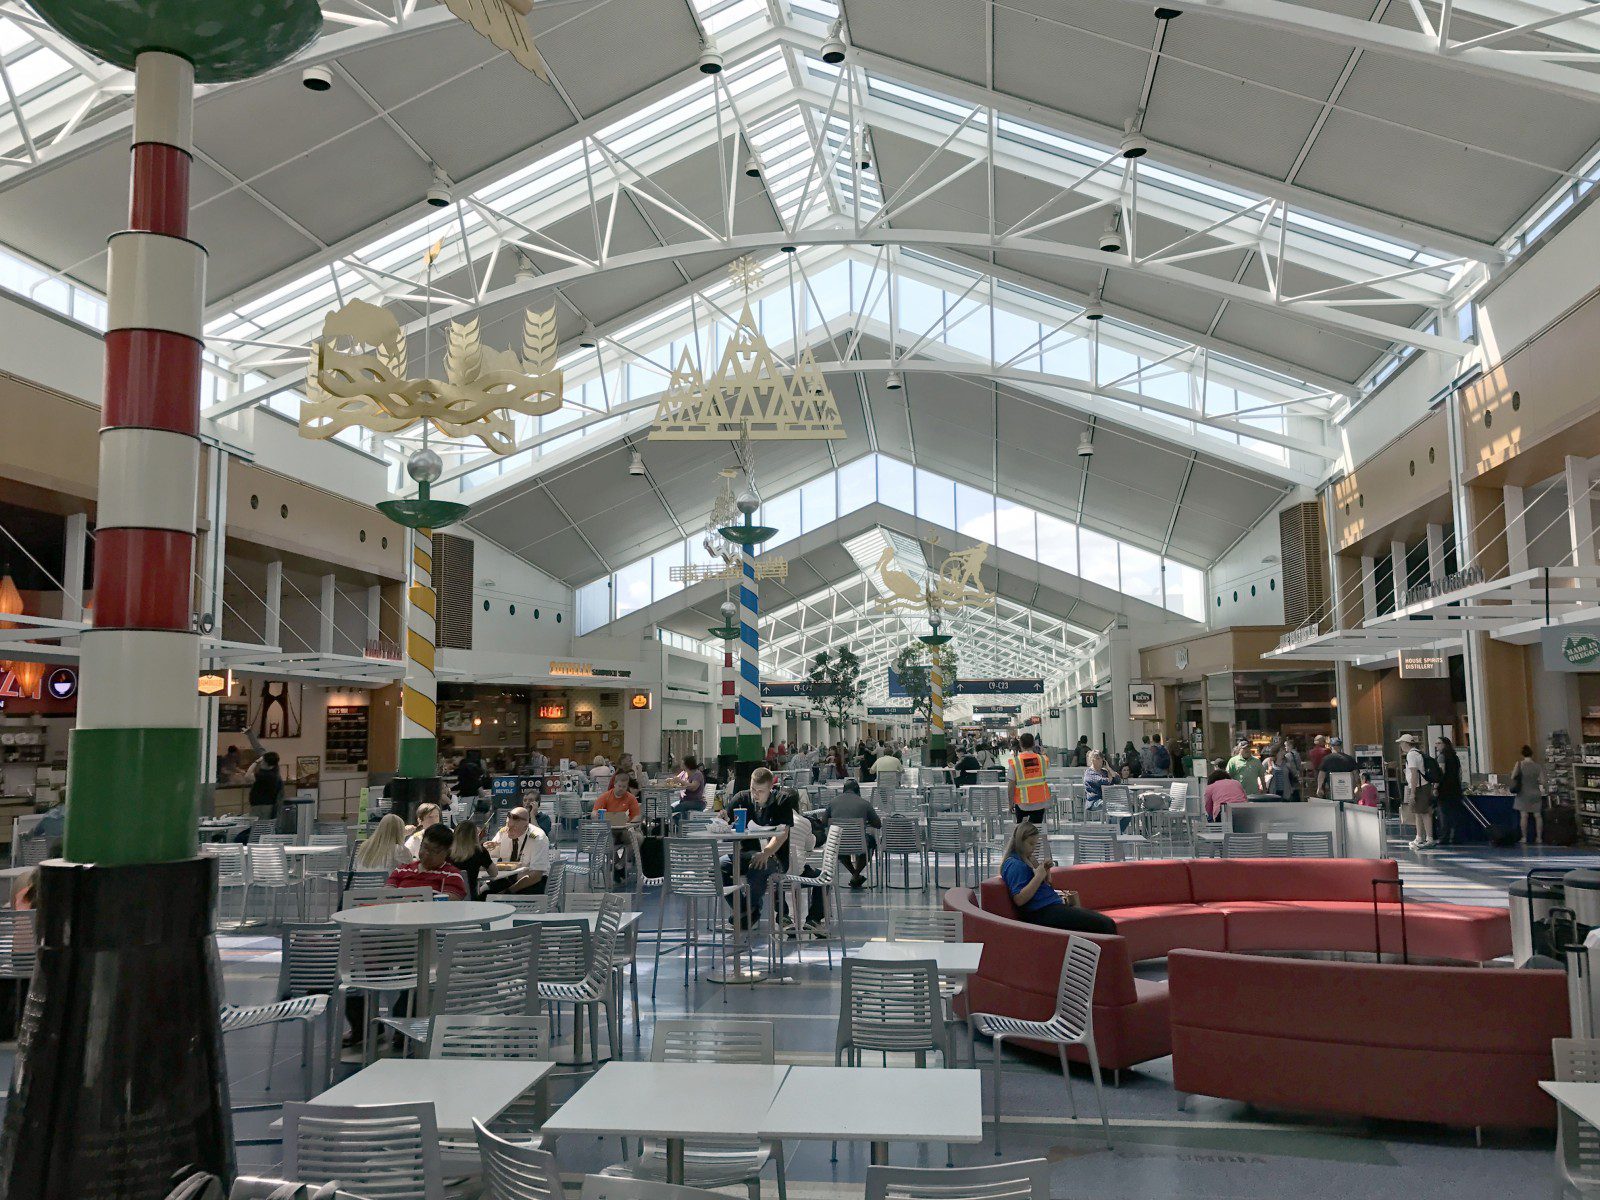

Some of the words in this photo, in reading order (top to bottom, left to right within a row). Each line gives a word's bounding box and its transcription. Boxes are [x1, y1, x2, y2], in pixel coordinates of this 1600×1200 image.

[1566, 644, 1586, 657] MADE
[1587, 641, 1598, 652] IN
[1567, 647, 1600, 662] OREGON
[988, 681, 1009, 690] C9-C23
[1085, 695, 1094, 704] C8
